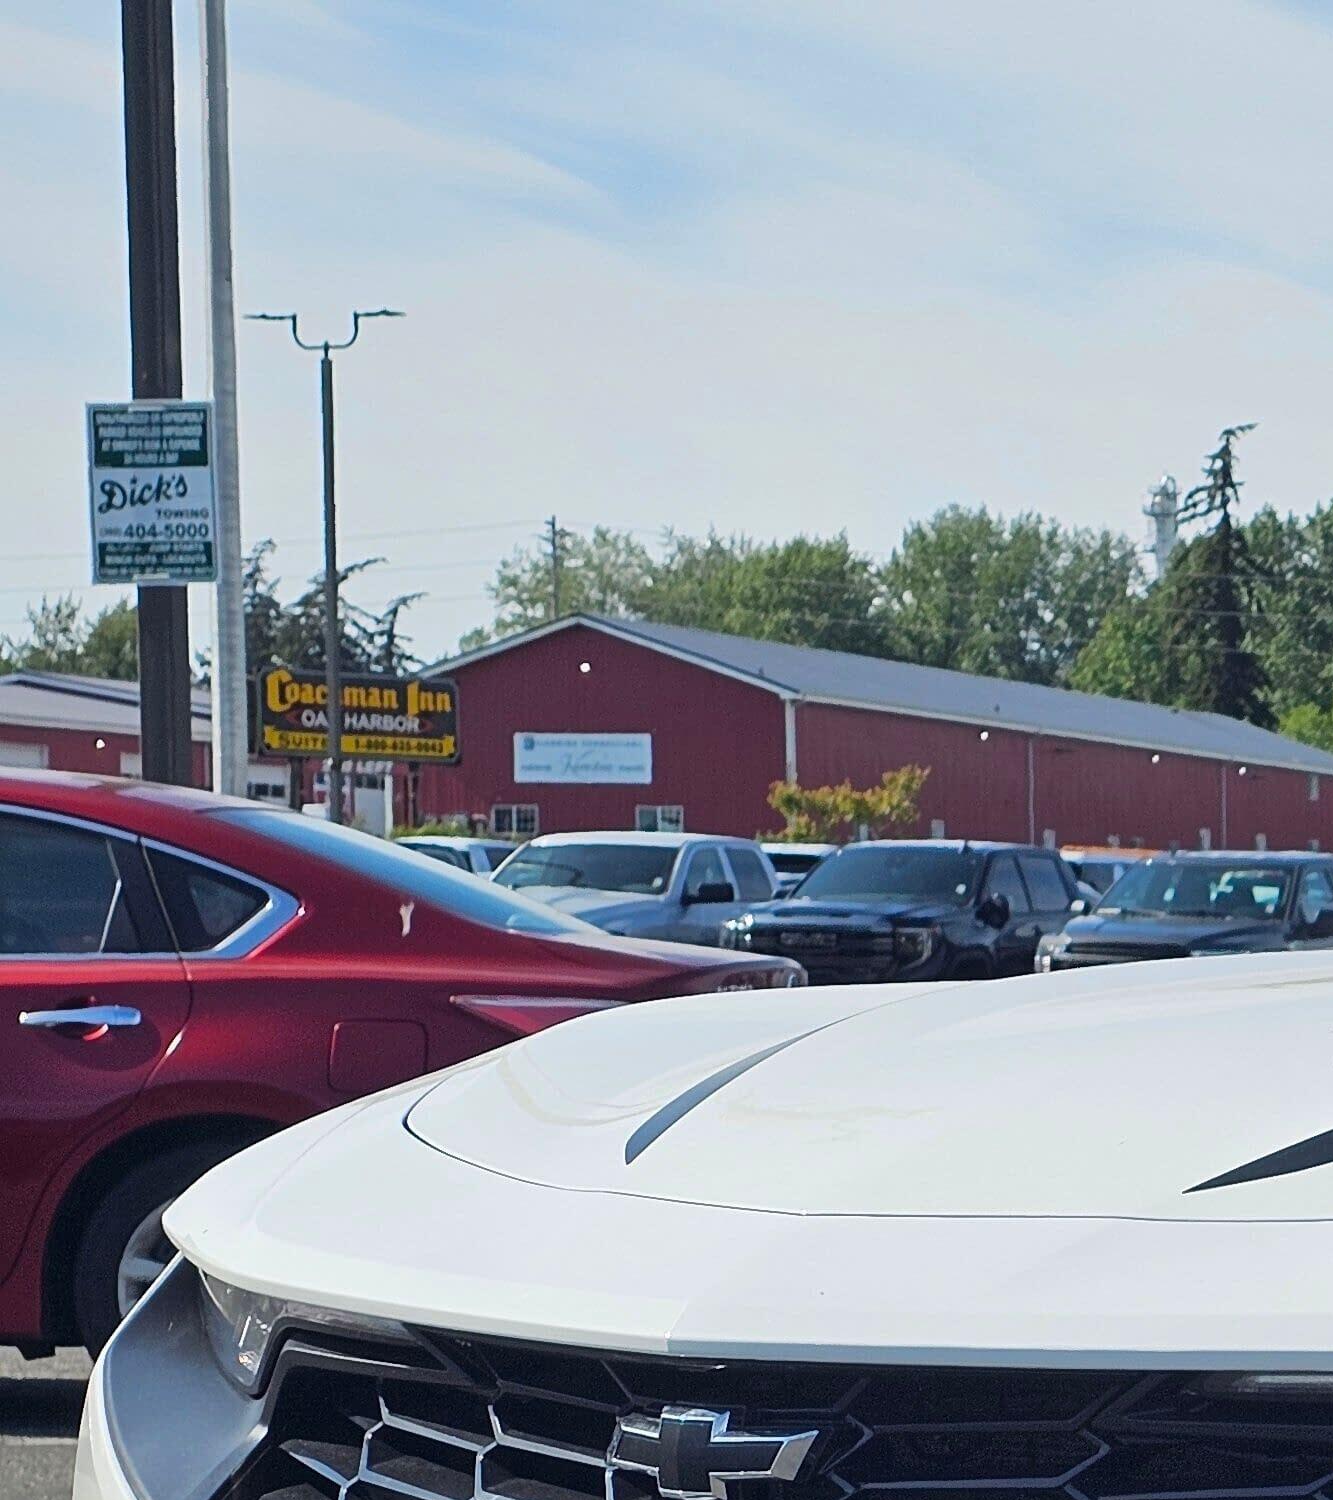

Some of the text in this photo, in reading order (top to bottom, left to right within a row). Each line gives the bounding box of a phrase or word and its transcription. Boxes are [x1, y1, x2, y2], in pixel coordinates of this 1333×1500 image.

[98, 473, 188, 513] Dick's
[156, 507, 209, 520] TOWING
[124, 523, 209, 538] 404-5000
[266, 669, 452, 716] Coacman Inn
[301, 709, 421, 734] OA HARBOR
